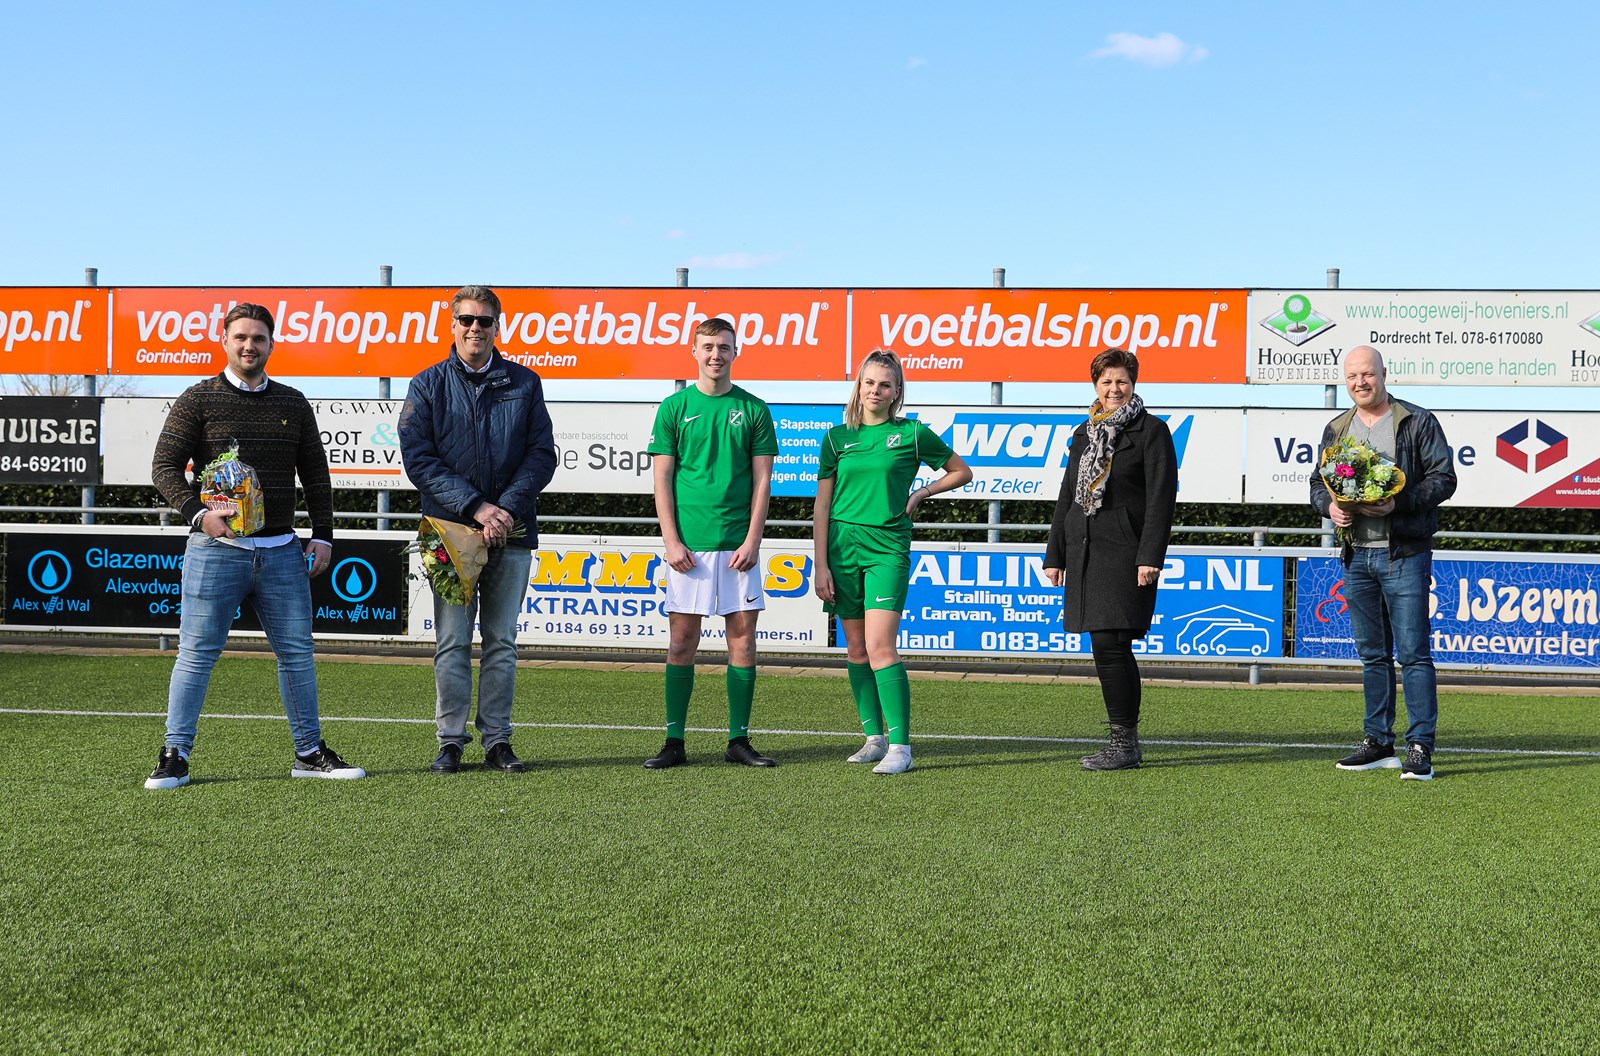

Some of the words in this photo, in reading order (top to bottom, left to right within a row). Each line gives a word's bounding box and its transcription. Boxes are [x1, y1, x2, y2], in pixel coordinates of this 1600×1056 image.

[1345, 301, 1568, 323] www.hoogeweij-hoveniers.nl
[136, 301, 440, 354] voetlshop.nl
[1369, 331, 1431, 345] Dordrecht
[1435, 332, 1457, 345] Tel.
[1461, 332, 1543, 345] 078-6170080
[136, 348, 212, 364] Gorinchem
[900, 353, 964, 370] rinchem
[1257, 368, 1339, 381] HOVENIERS
[1388, 357, 1416, 375] tuin
[1422, 357, 1434, 375] in
[1440, 361, 1494, 380] groene
[1499, 358, 1557, 377] handen
[780, 418, 834, 432] Stapsteen
[582, 432, 629, 441] basisschool
[781, 438, 820, 447] scoren.
[363, 449, 401, 465] B.V.
[1273, 437, 1321, 464] Va
[588, 443, 651, 477] Stap
[802, 453, 820, 465] kin
[799, 470, 818, 482] doe
[1272, 471, 1312, 483] onder
[963, 481, 986, 494] en
[85, 548, 186, 570] Glazenwa
[105, 578, 181, 595] Alexvdwa
[12, 598, 39, 611] Alex
[67, 599, 91, 612] Wal
[944, 589, 1012, 608] Stalling
[1017, 594, 1063, 606] voor:
[1456, 577, 1600, 625] IJzerm
[315, 606, 343, 620] Alex
[372, 607, 397, 621] Wal
[921, 606, 997, 624] Caravan,
[1003, 608, 1051, 625] Boot,
[545, 622, 583, 634] 0184
[590, 623, 608, 635] 69
[614, 624, 632, 636] 13
[637, 625, 655, 637] 21
